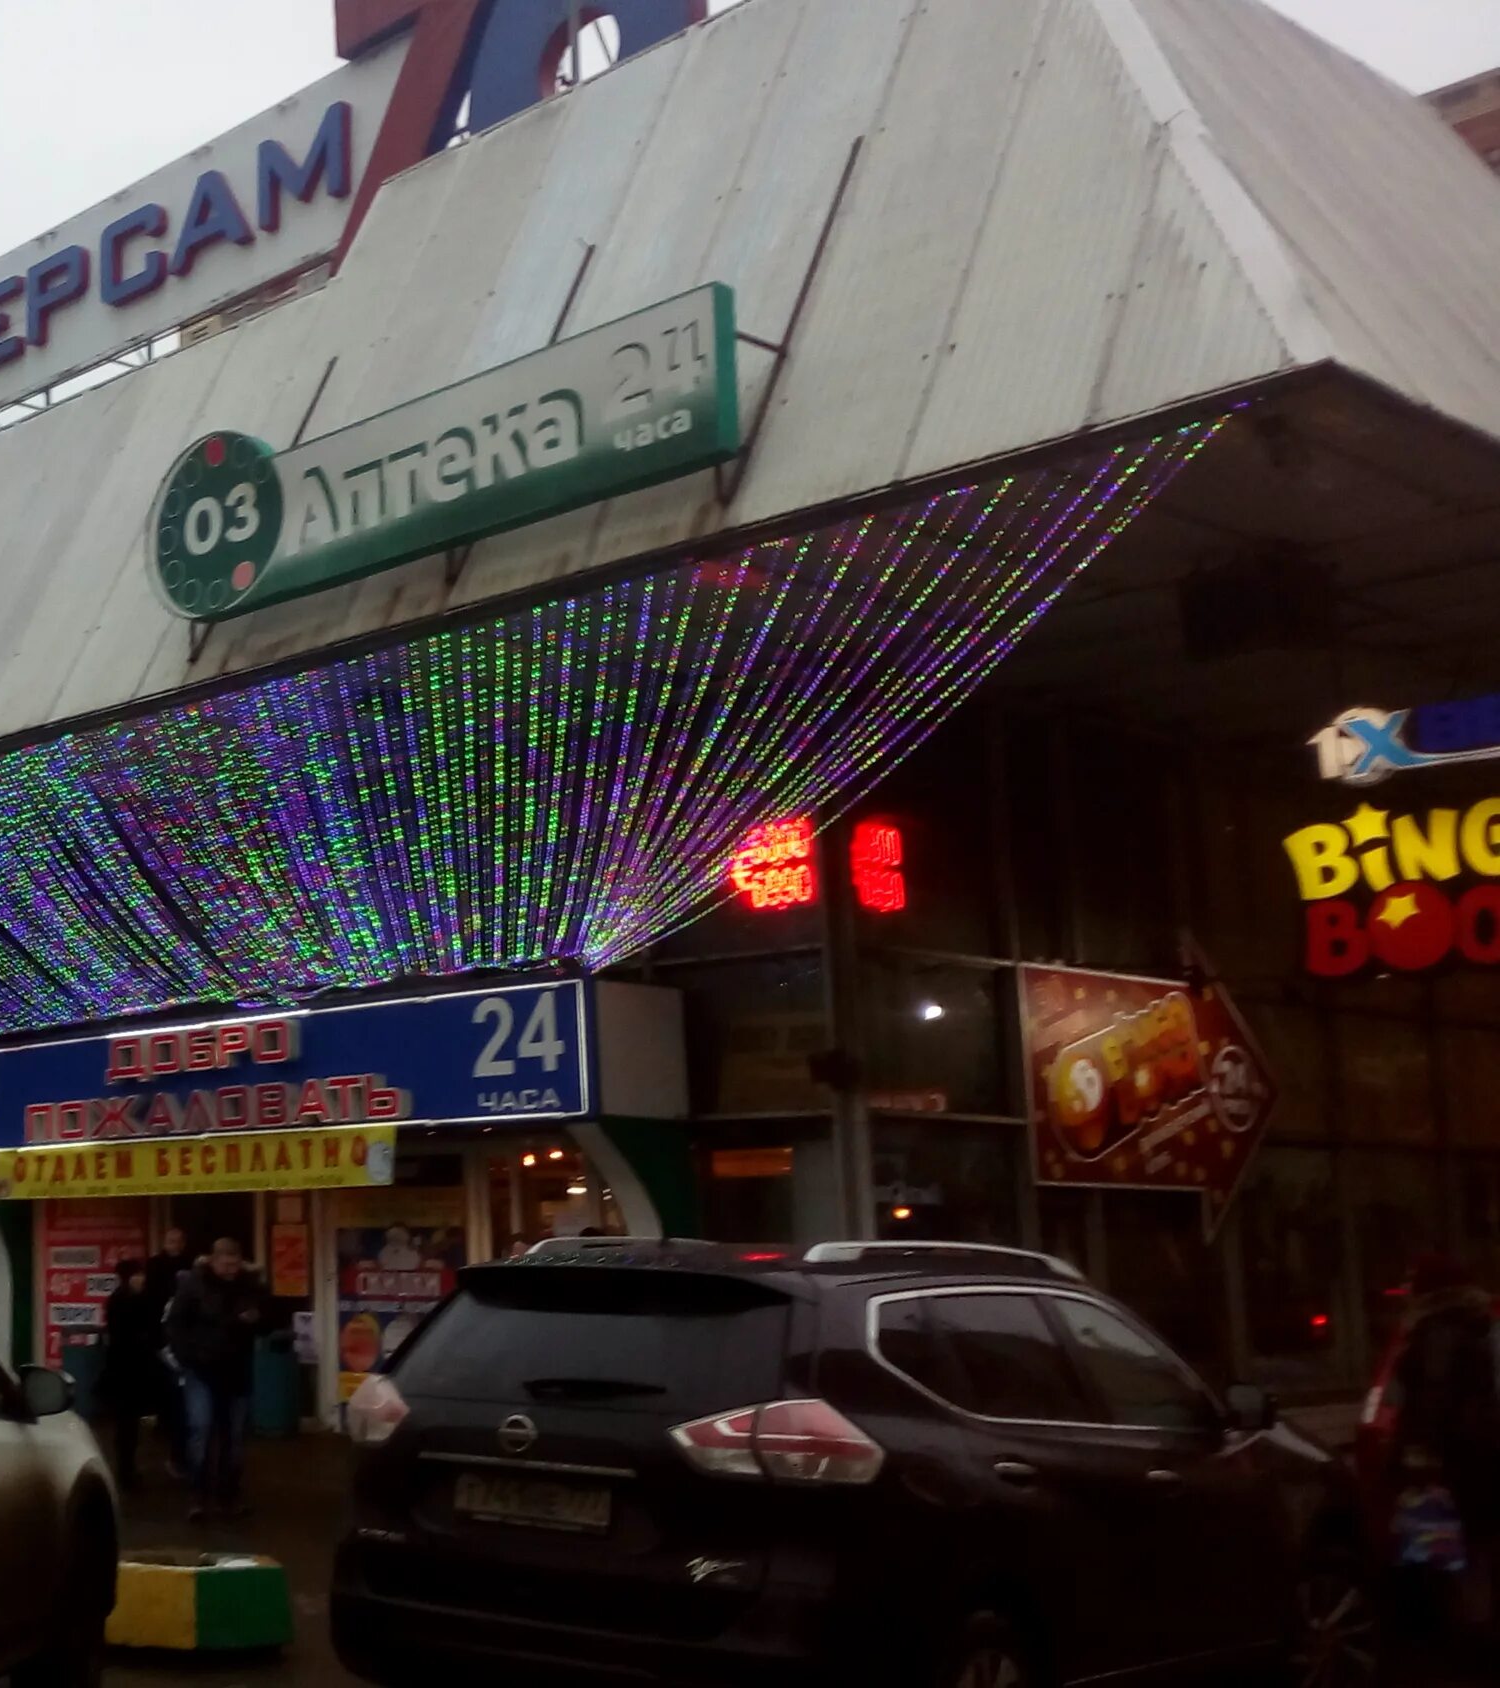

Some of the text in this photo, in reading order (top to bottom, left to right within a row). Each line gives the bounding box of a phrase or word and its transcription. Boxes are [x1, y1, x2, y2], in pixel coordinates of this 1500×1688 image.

[612, 408, 693, 453] часа
[285, 387, 585, 557] Аптека
[184, 481, 260, 556] 03
[106, 1019, 297, 1084] ДОБРО
[471, 990, 565, 1078] 24
[24, 1072, 408, 1144] ПОЖАЛОВАТЬ
[477, 1087, 562, 1113] ЧАСА
[12, 1135, 368, 1184] ОТДАЕМ БЕСПЛАТНО
